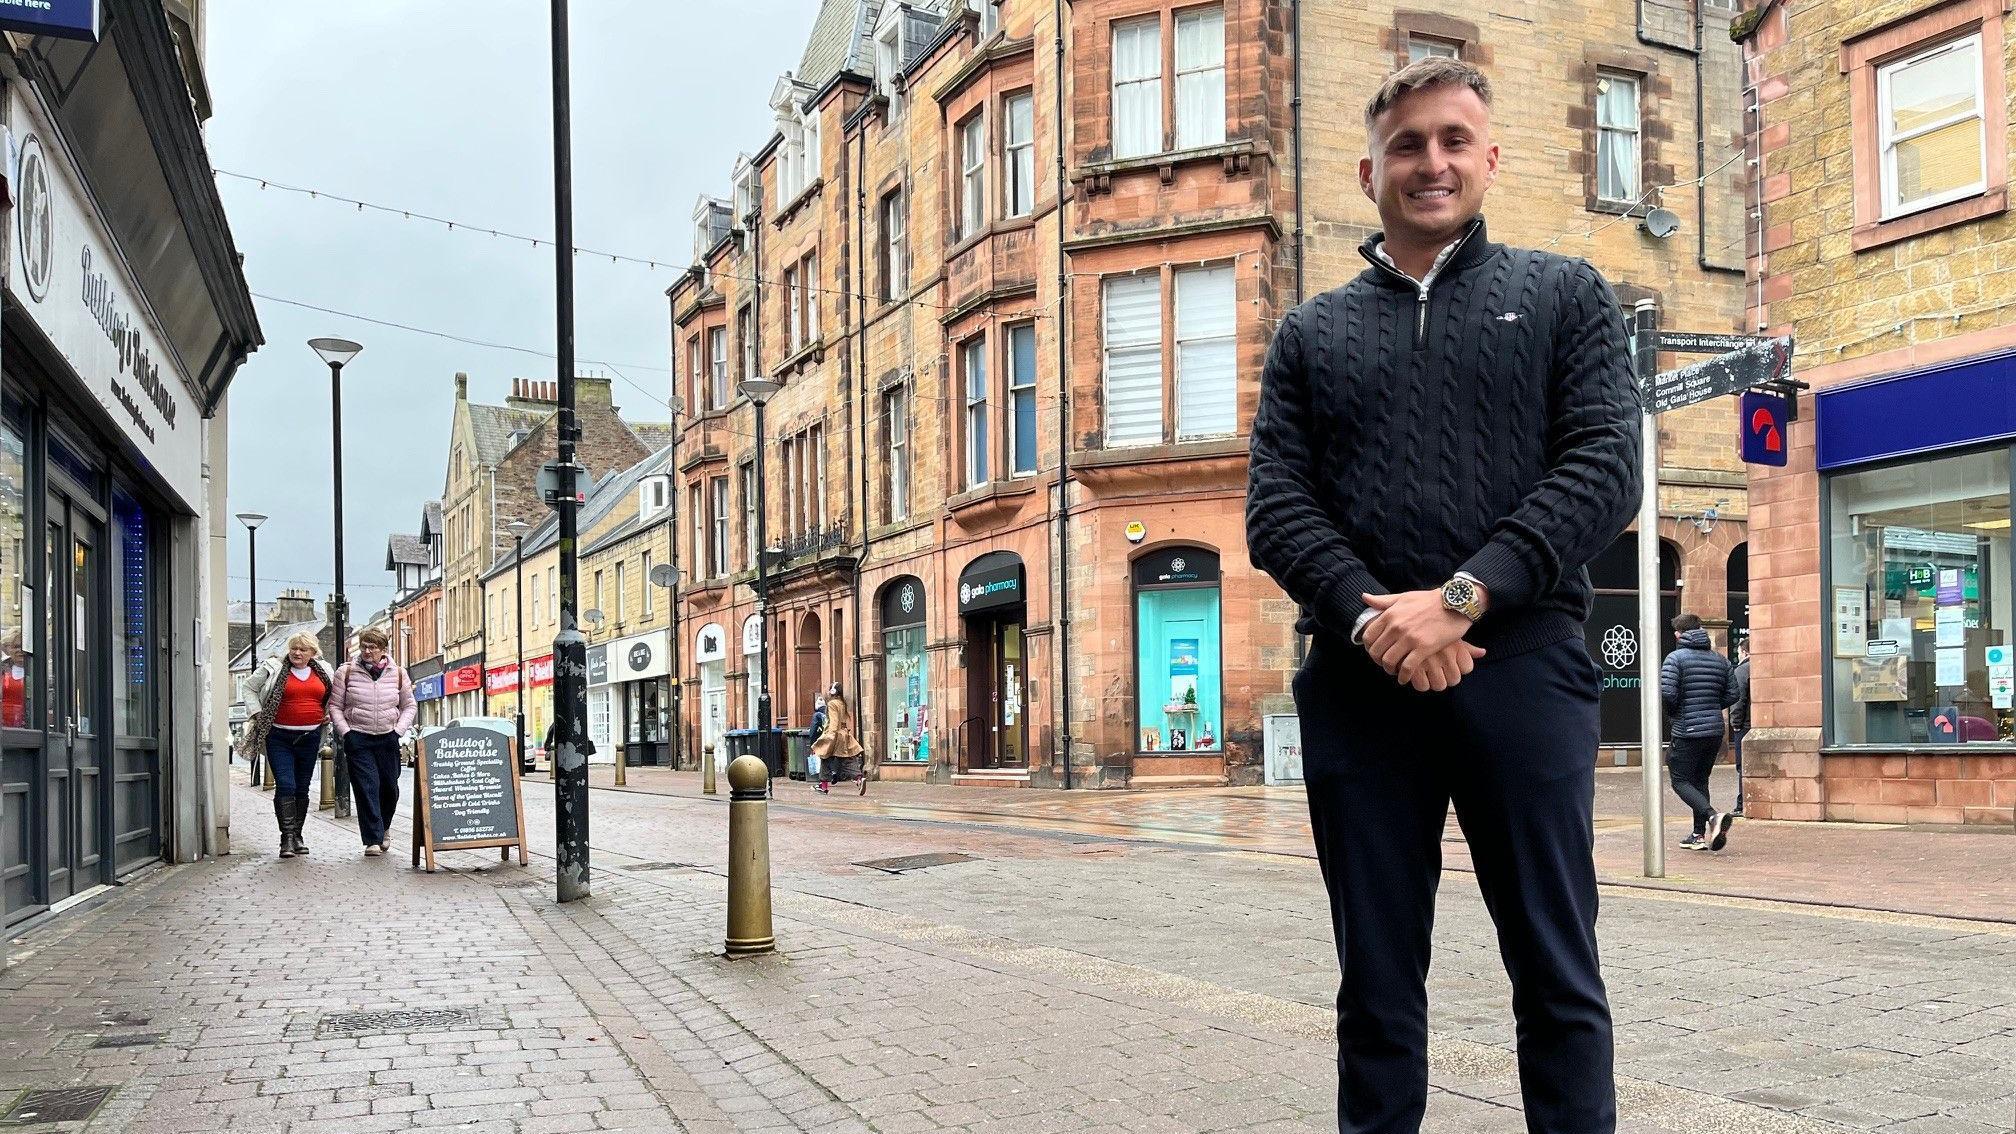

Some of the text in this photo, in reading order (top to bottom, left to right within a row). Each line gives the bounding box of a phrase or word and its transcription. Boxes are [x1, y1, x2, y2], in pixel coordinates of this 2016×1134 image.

[24, 0, 51, 10] here
[81, 244, 176, 431] Bulldog's Bakehouse
[1660, 336, 1697, 347] Transport
[1699, 338, 1744, 350] Interchange
[1680, 368, 1700, 380] Place
[1685, 376, 1711, 388] Square
[1655, 386, 1712, 408] Old Gala House
[971, 578, 1016, 599] gala pharmacy
[1602, 674, 1642, 692] pharm
[438, 736, 492, 750] Bulldog's
[434, 748, 498, 758] Bakehouse
